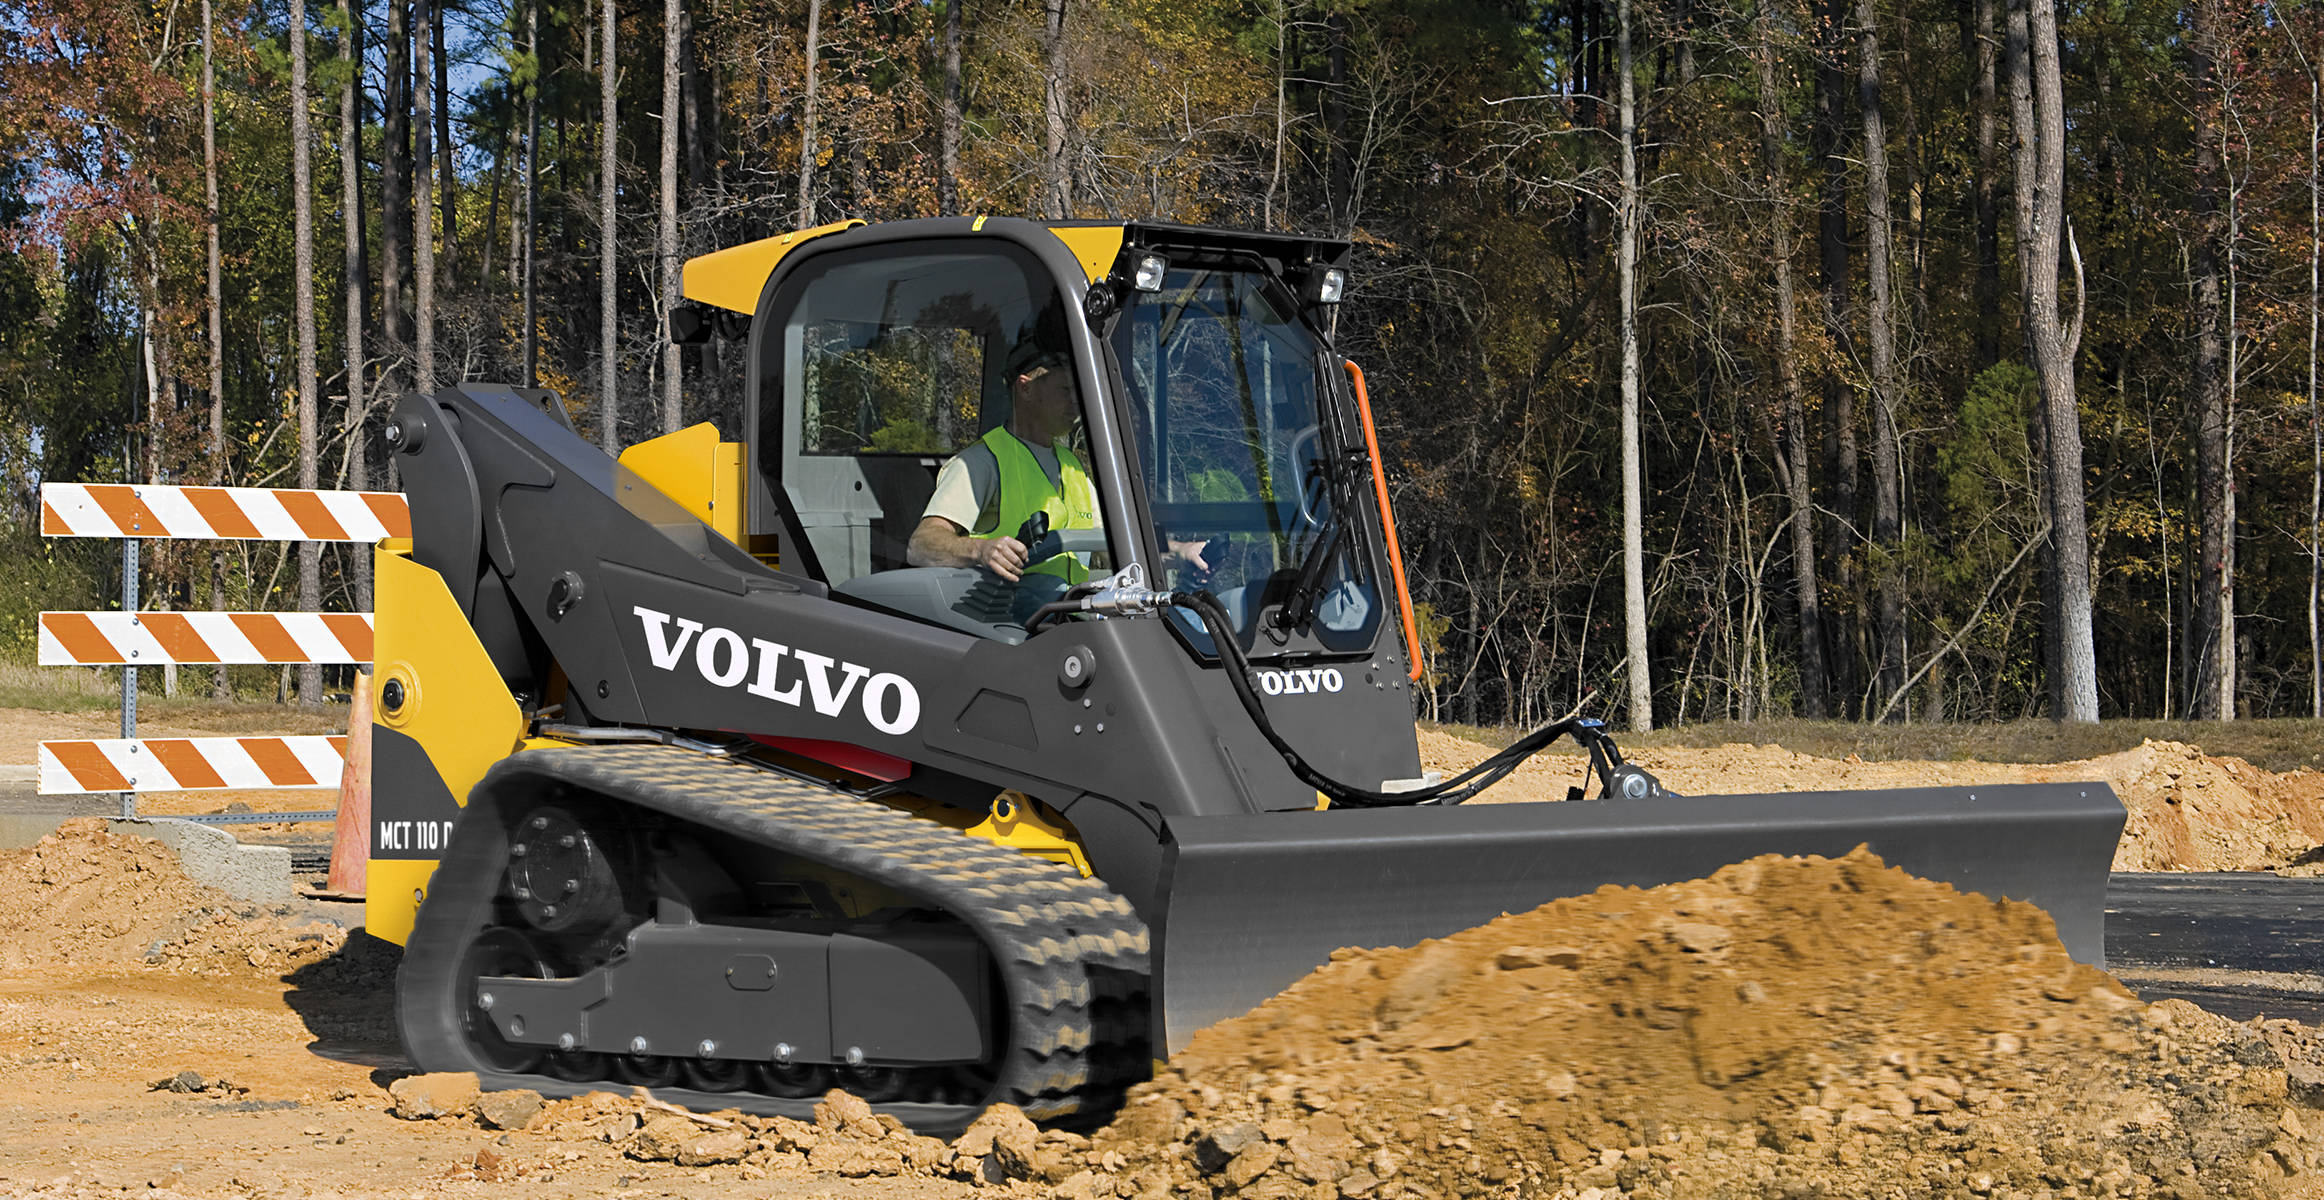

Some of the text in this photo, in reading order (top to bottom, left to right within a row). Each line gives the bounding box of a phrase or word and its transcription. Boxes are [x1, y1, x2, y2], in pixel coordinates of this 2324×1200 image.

[633, 606, 921, 735] VOLVO
[1256, 668, 1344, 696] OLVO
[381, 821, 412, 850] MCT
[416, 821, 439, 850] 110
